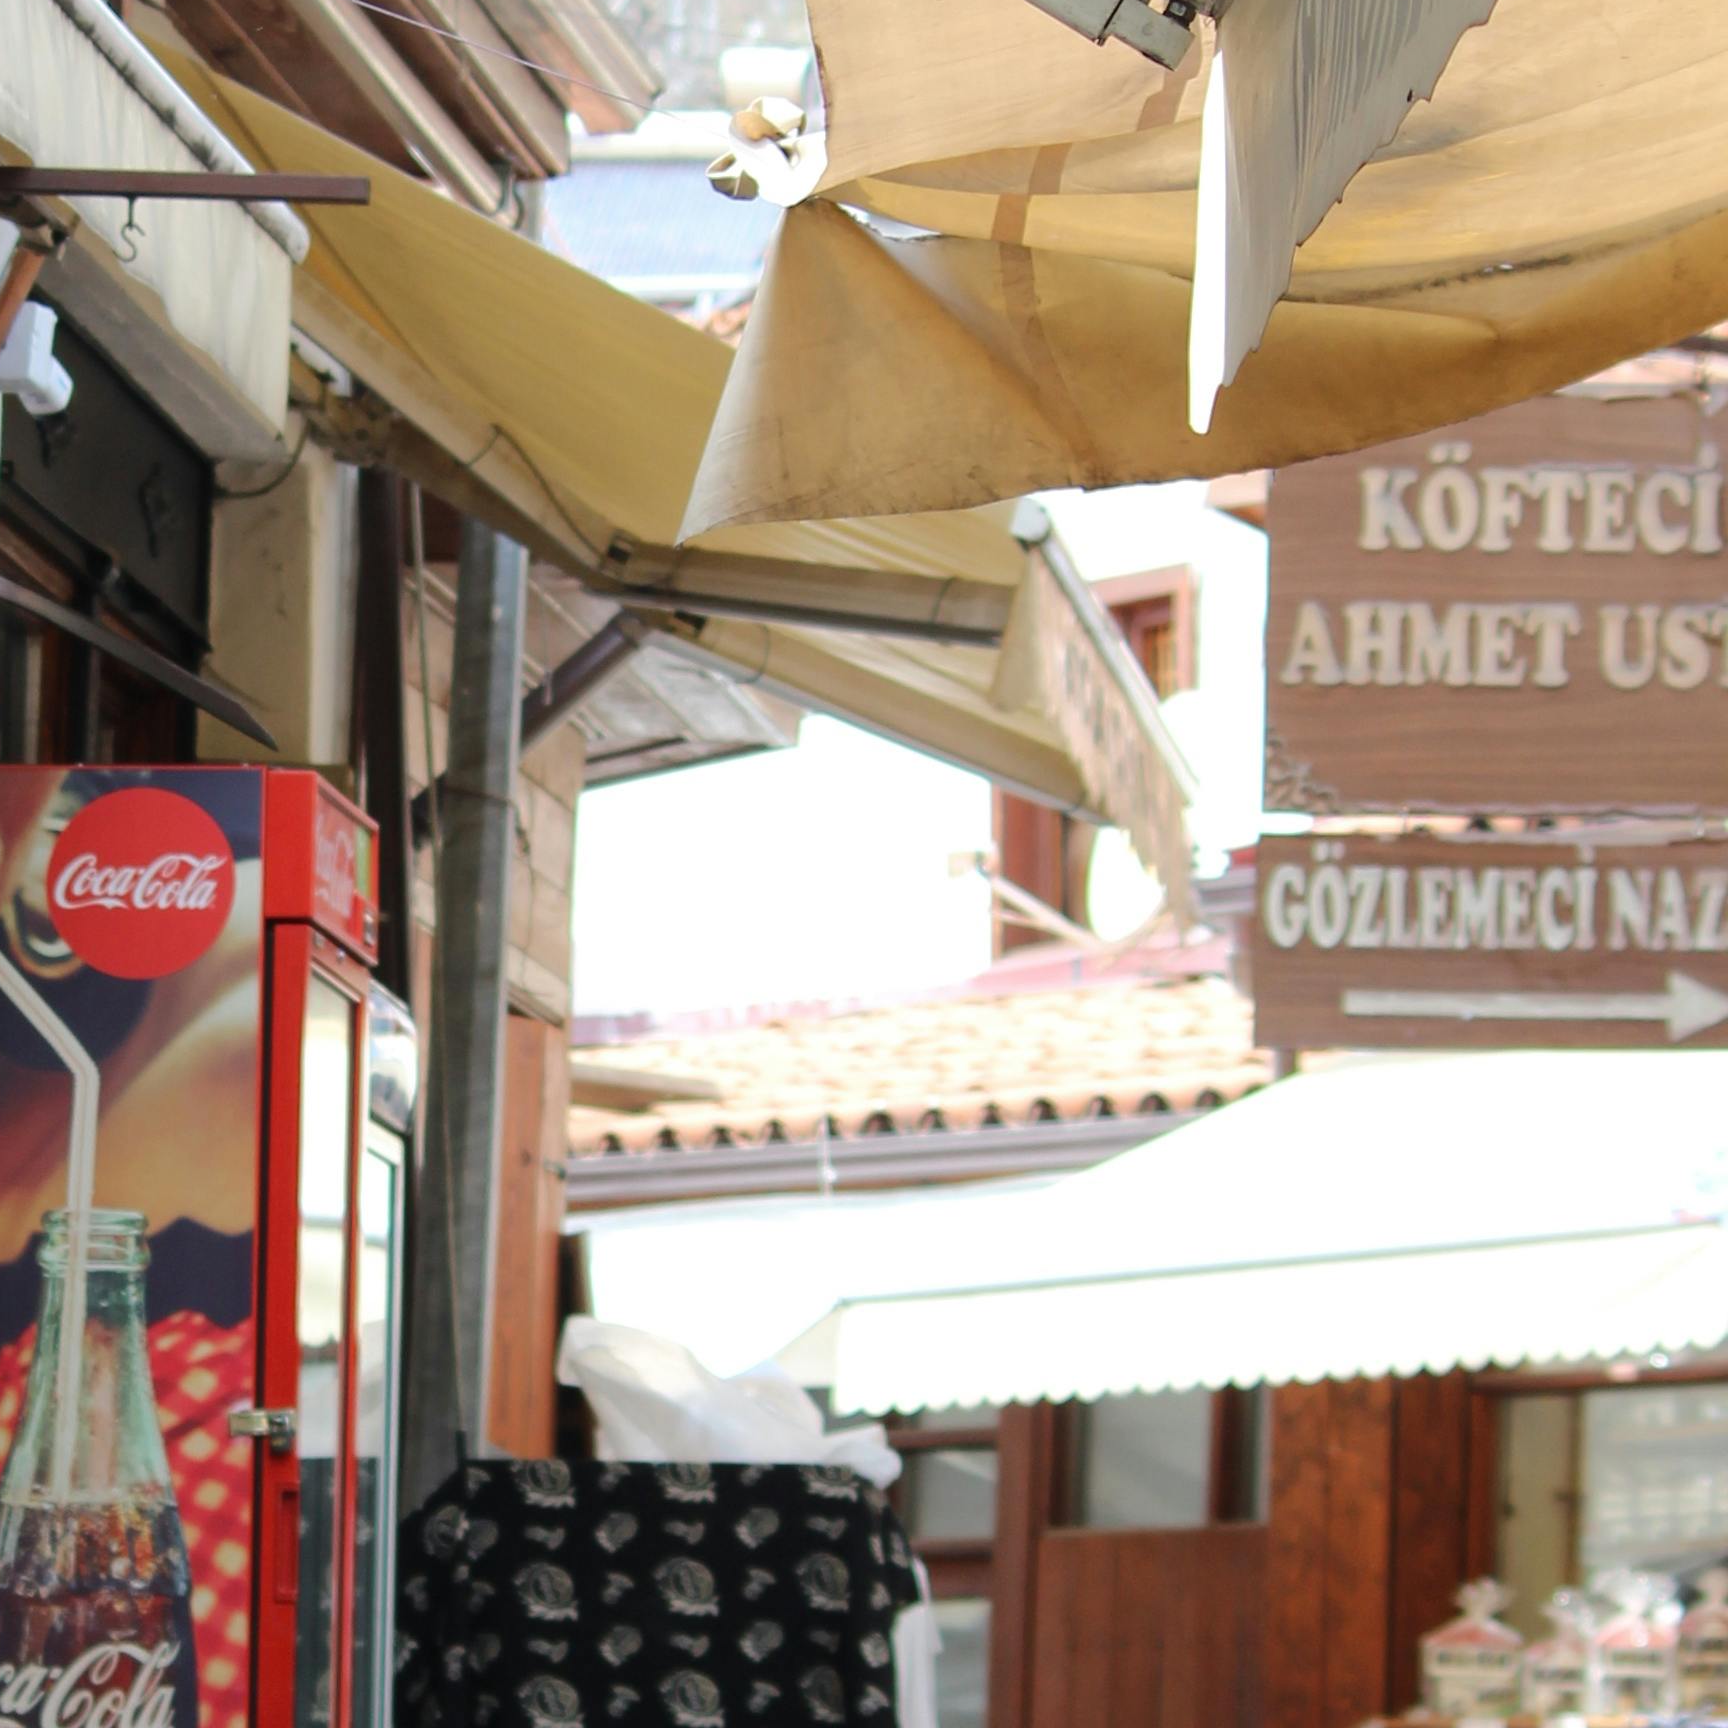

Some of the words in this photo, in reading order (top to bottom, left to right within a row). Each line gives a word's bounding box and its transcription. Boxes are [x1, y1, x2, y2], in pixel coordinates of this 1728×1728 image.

[1360, 443, 1723, 553] KÖFTECİ
[1279, 601, 1579, 687] AHMET
[1599, 604, 1728, 688] US
[53, 853, 227, 910] Coca-Cola
[1263, 844, 1597, 950] GÖZLEMECİ
